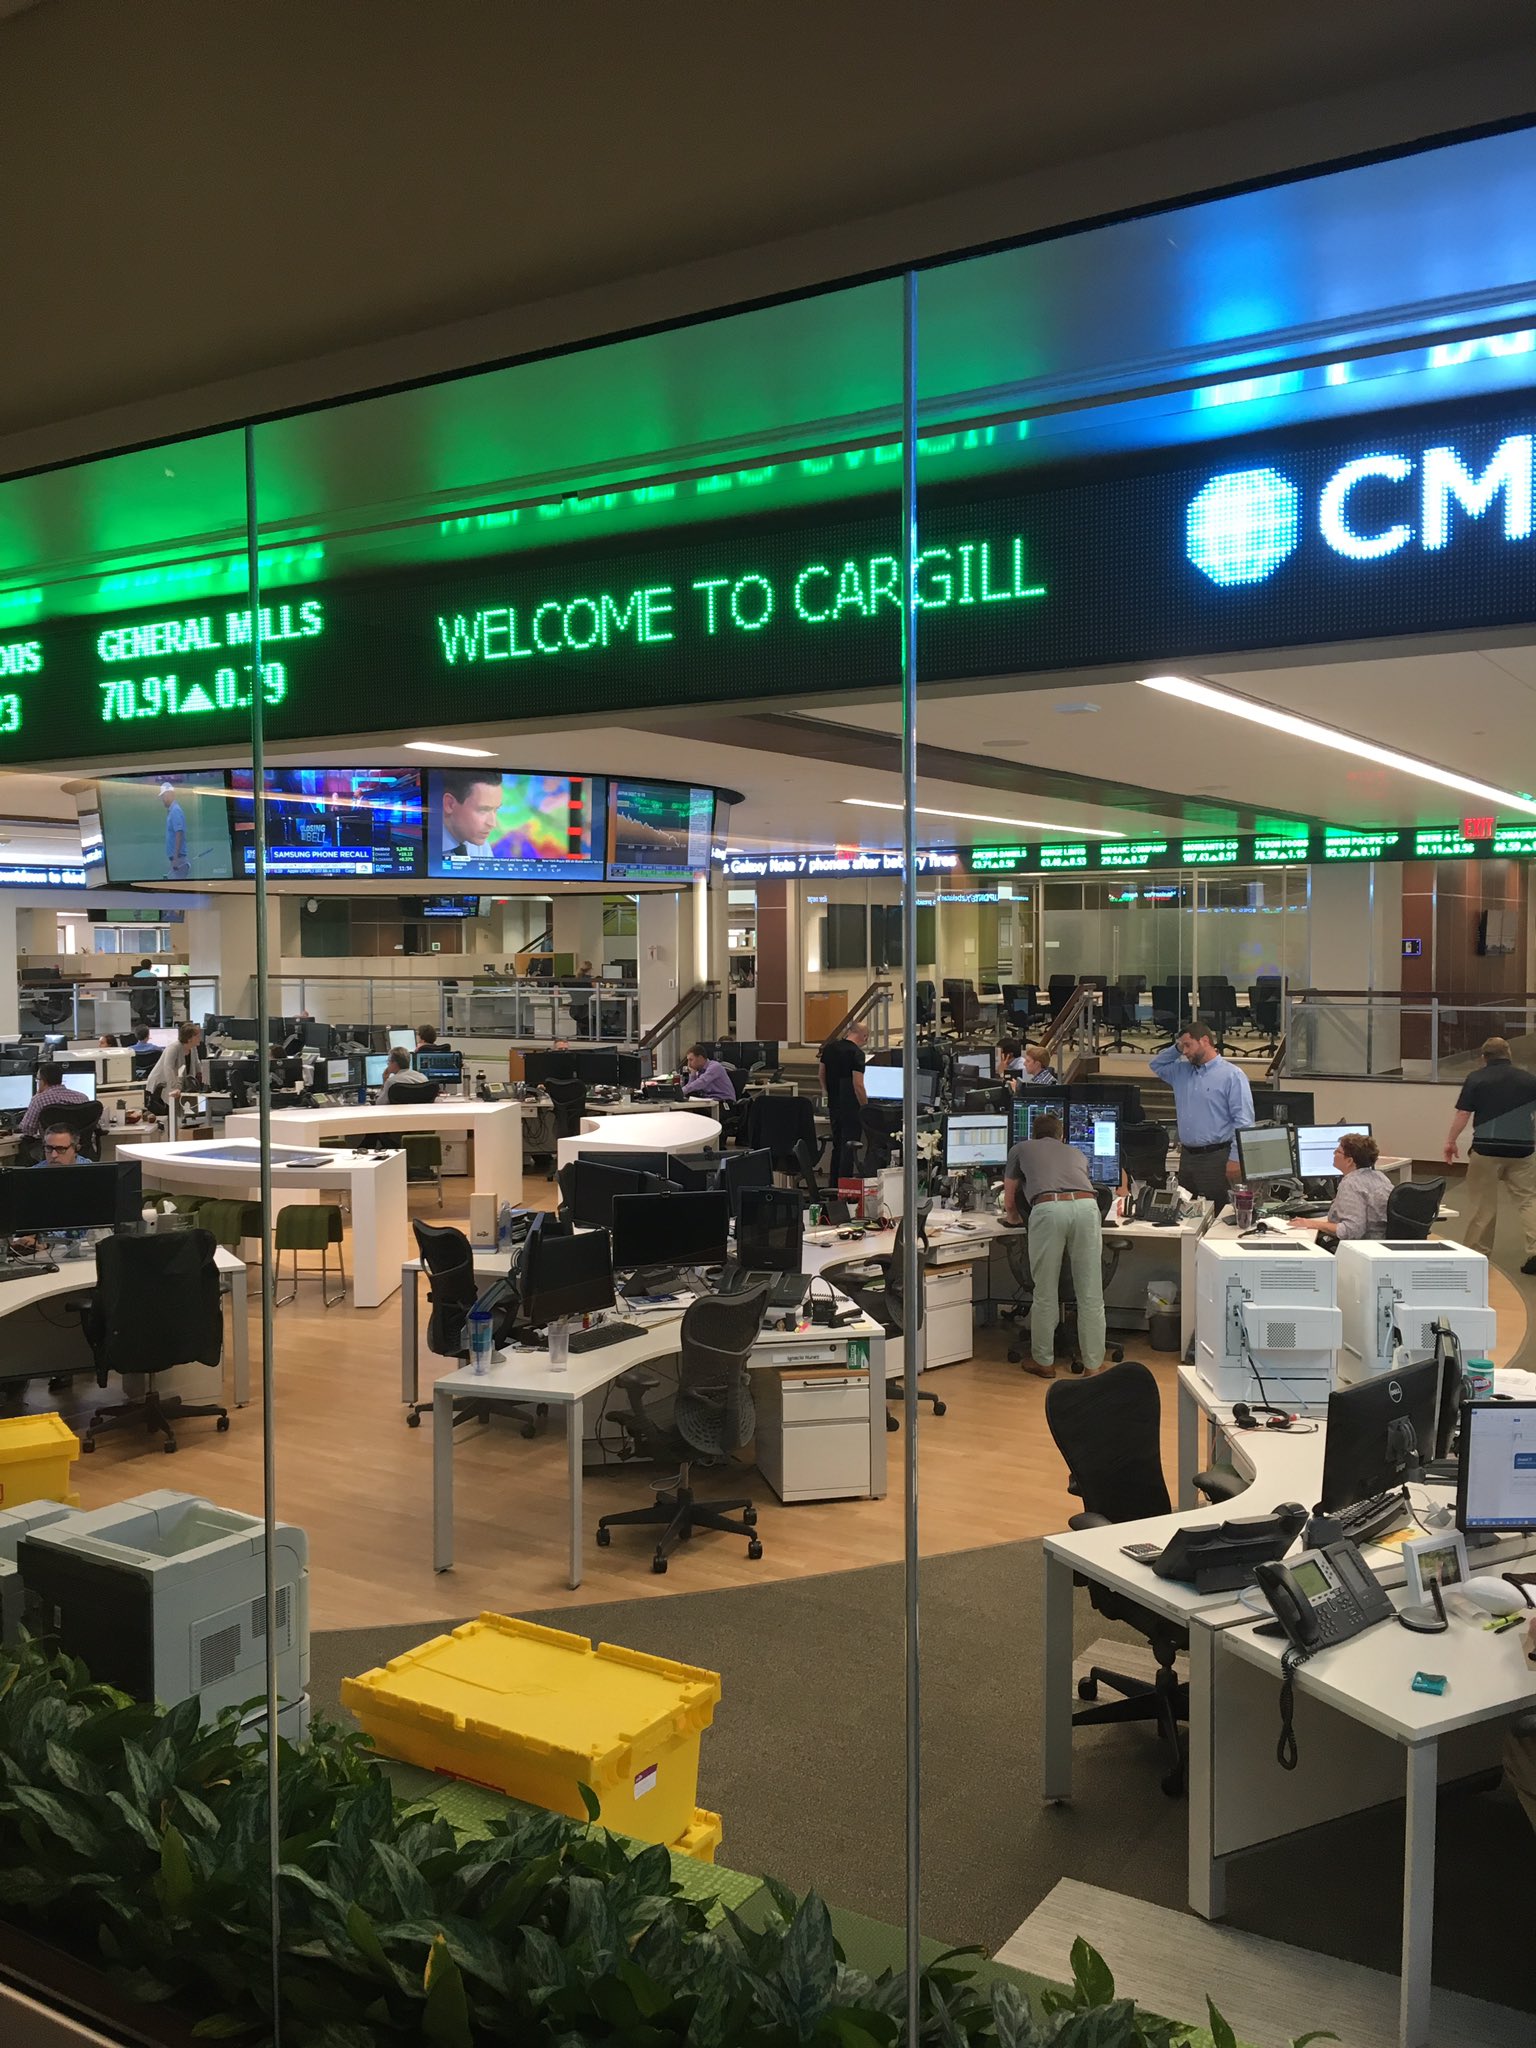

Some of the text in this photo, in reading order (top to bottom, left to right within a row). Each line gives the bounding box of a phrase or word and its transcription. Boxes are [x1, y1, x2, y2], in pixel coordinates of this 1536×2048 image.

[1319, 433, 1536, 560] CM
[437, 537, 1047, 664] WELCOME TO CARGILL
[97, 601, 323, 662] GENERAL MILLS
[1464, 817, 1495, 838] EXIT
[306, 832, 329, 844] BELL
[1281, 839, 1309, 847] FOODS
[1325, 838, 1350, 846] UNION
[1351, 836, 1385, 845] PACIFIC
[1417, 834, 1443, 843] DEERE
[1453, 833, 1466, 842] C
[1101, 845, 1167, 855] MOSAIC COMPANY
[1182, 842, 1239, 851] MONSANTO CO
[731, 859, 767, 875] Galaxy
[770, 859, 796, 872] Note
[798, 858, 806, 871] 7
[809, 857, 850, 873] phones
[852, 855, 881, 869] after
[884, 855, 927, 870] batry
[929, 853, 957, 867] fires
